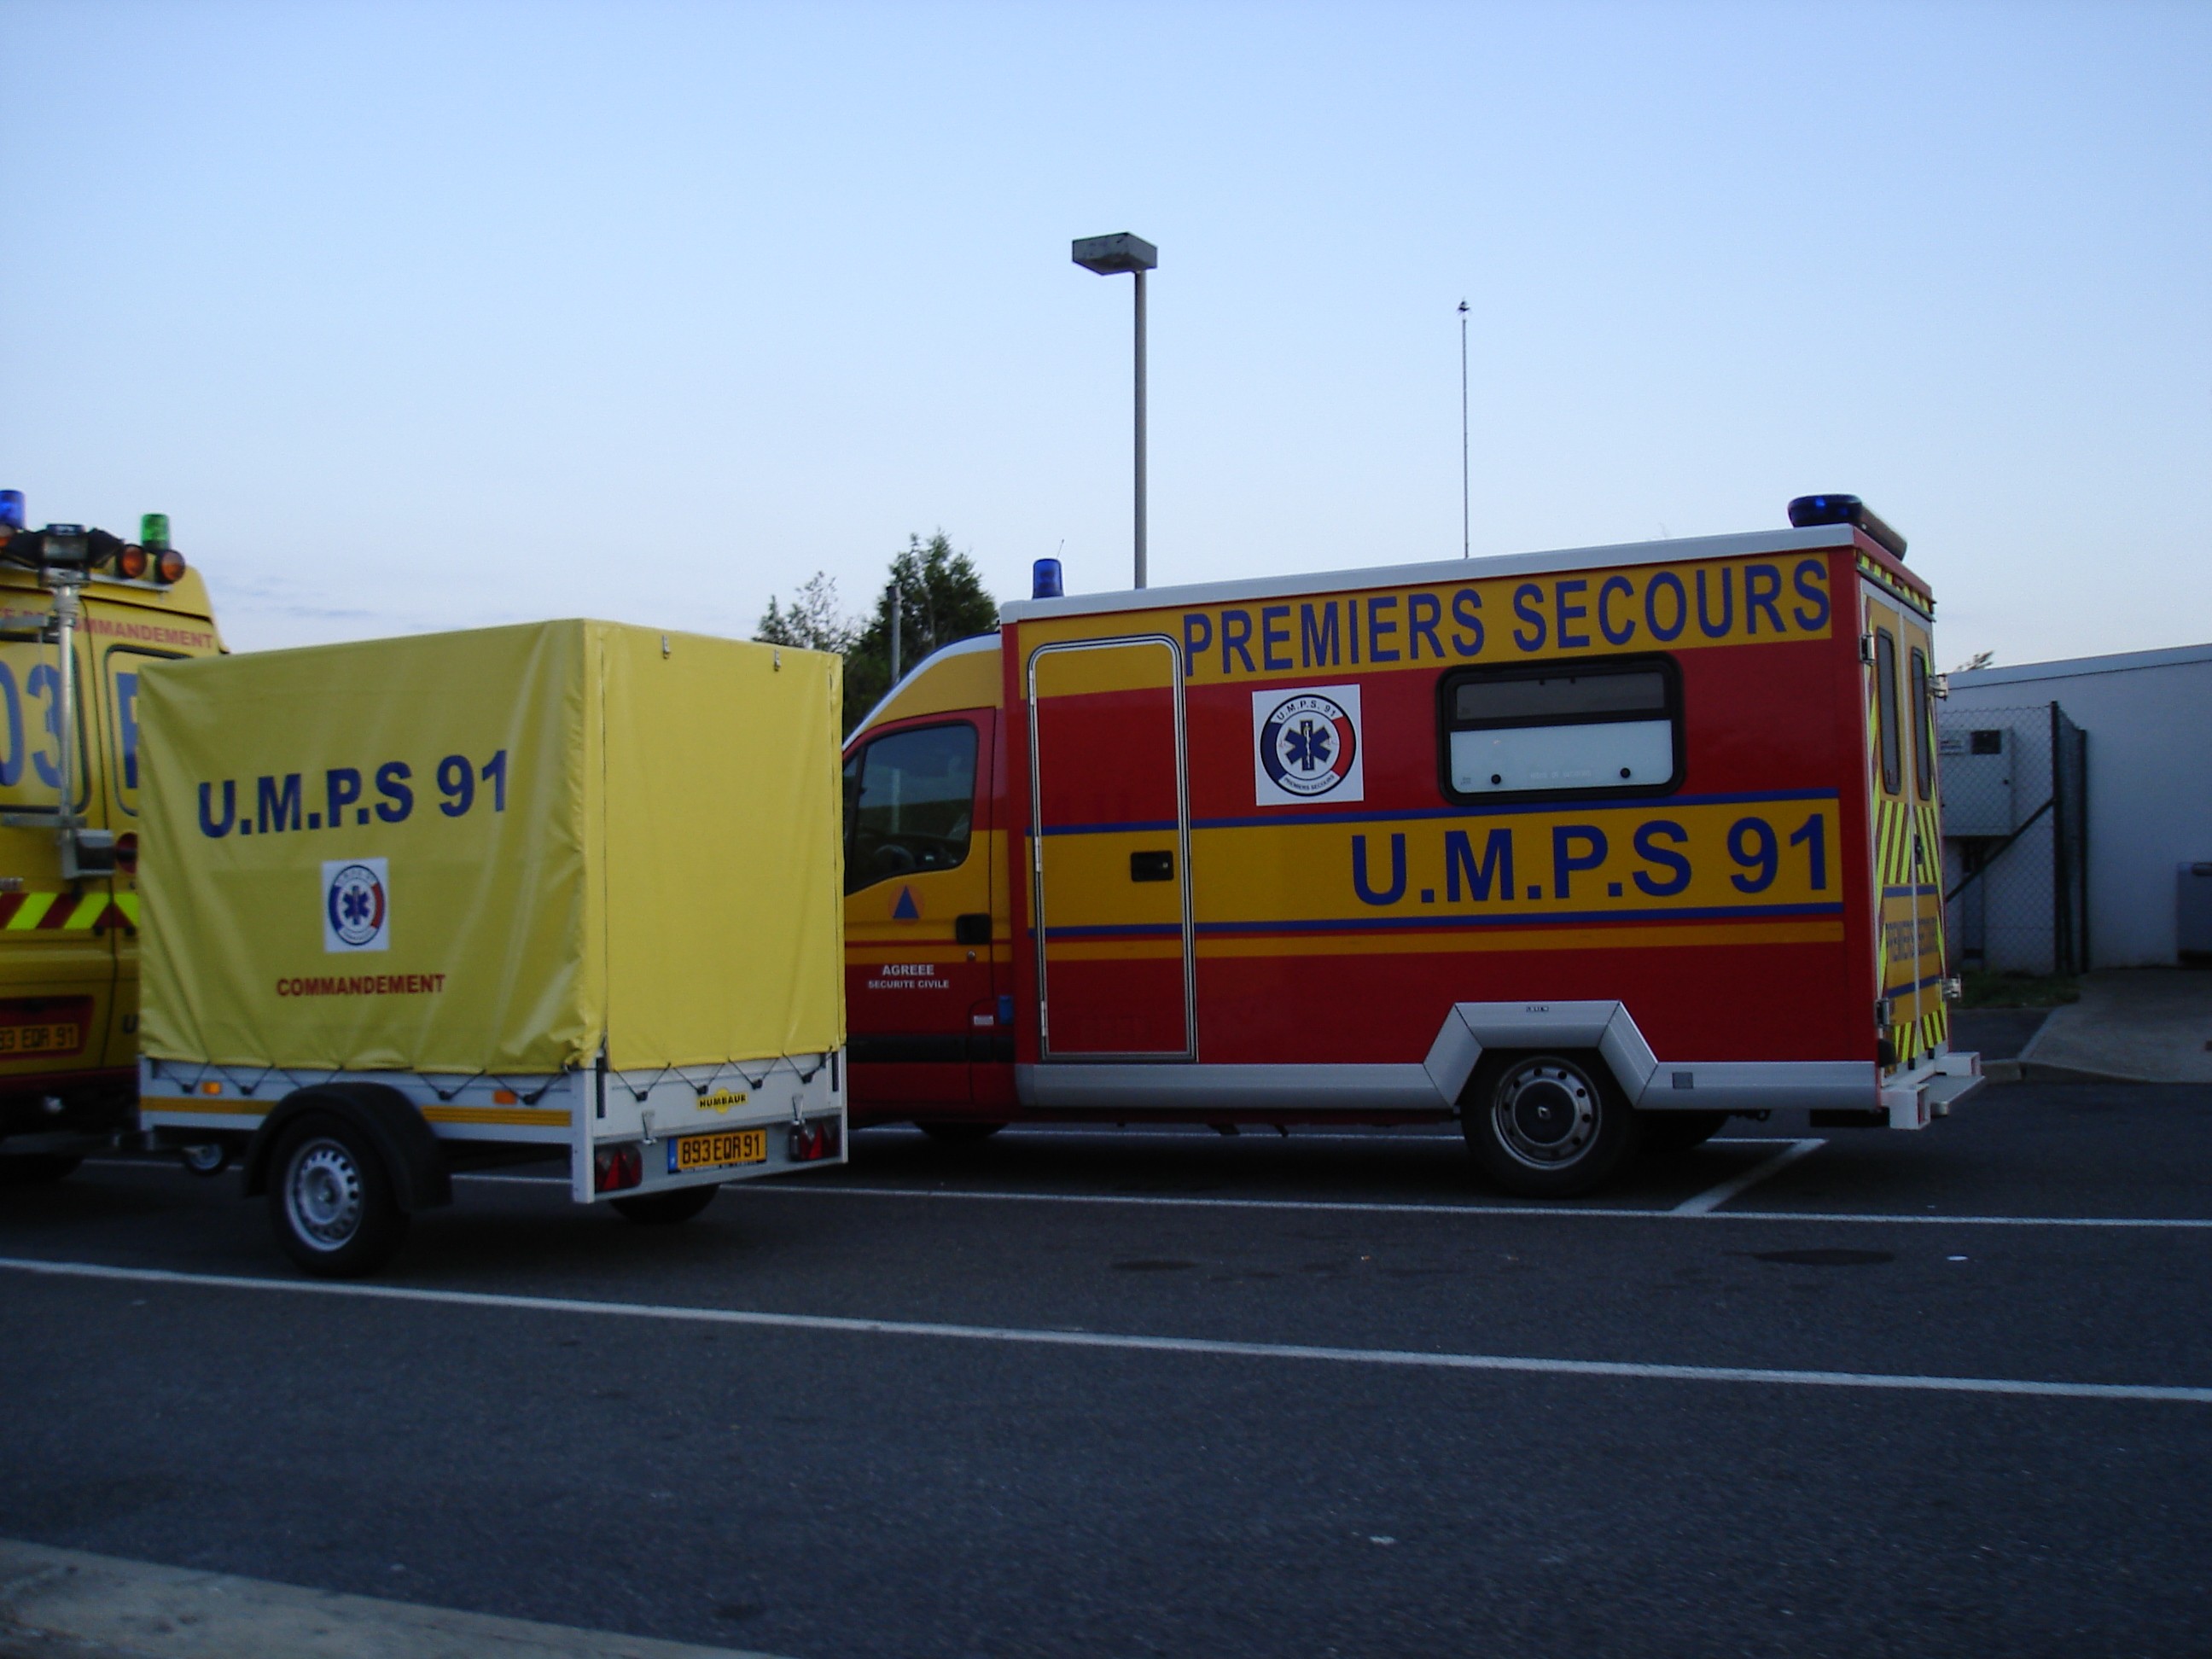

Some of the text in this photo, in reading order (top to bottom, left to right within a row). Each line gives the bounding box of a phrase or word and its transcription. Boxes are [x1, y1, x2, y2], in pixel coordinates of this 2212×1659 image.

[1182, 559, 1831, 677] PREMIERS SECOURS
[72, 615, 213, 649] OMMANDEMENT
[1324, 706, 1336, 717] 91
[197, 749, 507, 839] U.M.P.S 91
[1351, 812, 1827, 905] U.M.P.S 91
[882, 964, 934, 975] AGREEE
[276, 974, 446, 997] COMMANDEMENT
[868, 980, 950, 989] SECURITE CIVILE
[700, 1094, 746, 1108] HUMBAUR
[683, 1139, 711, 1164] 893
[744, 1134, 760, 1157] 91
